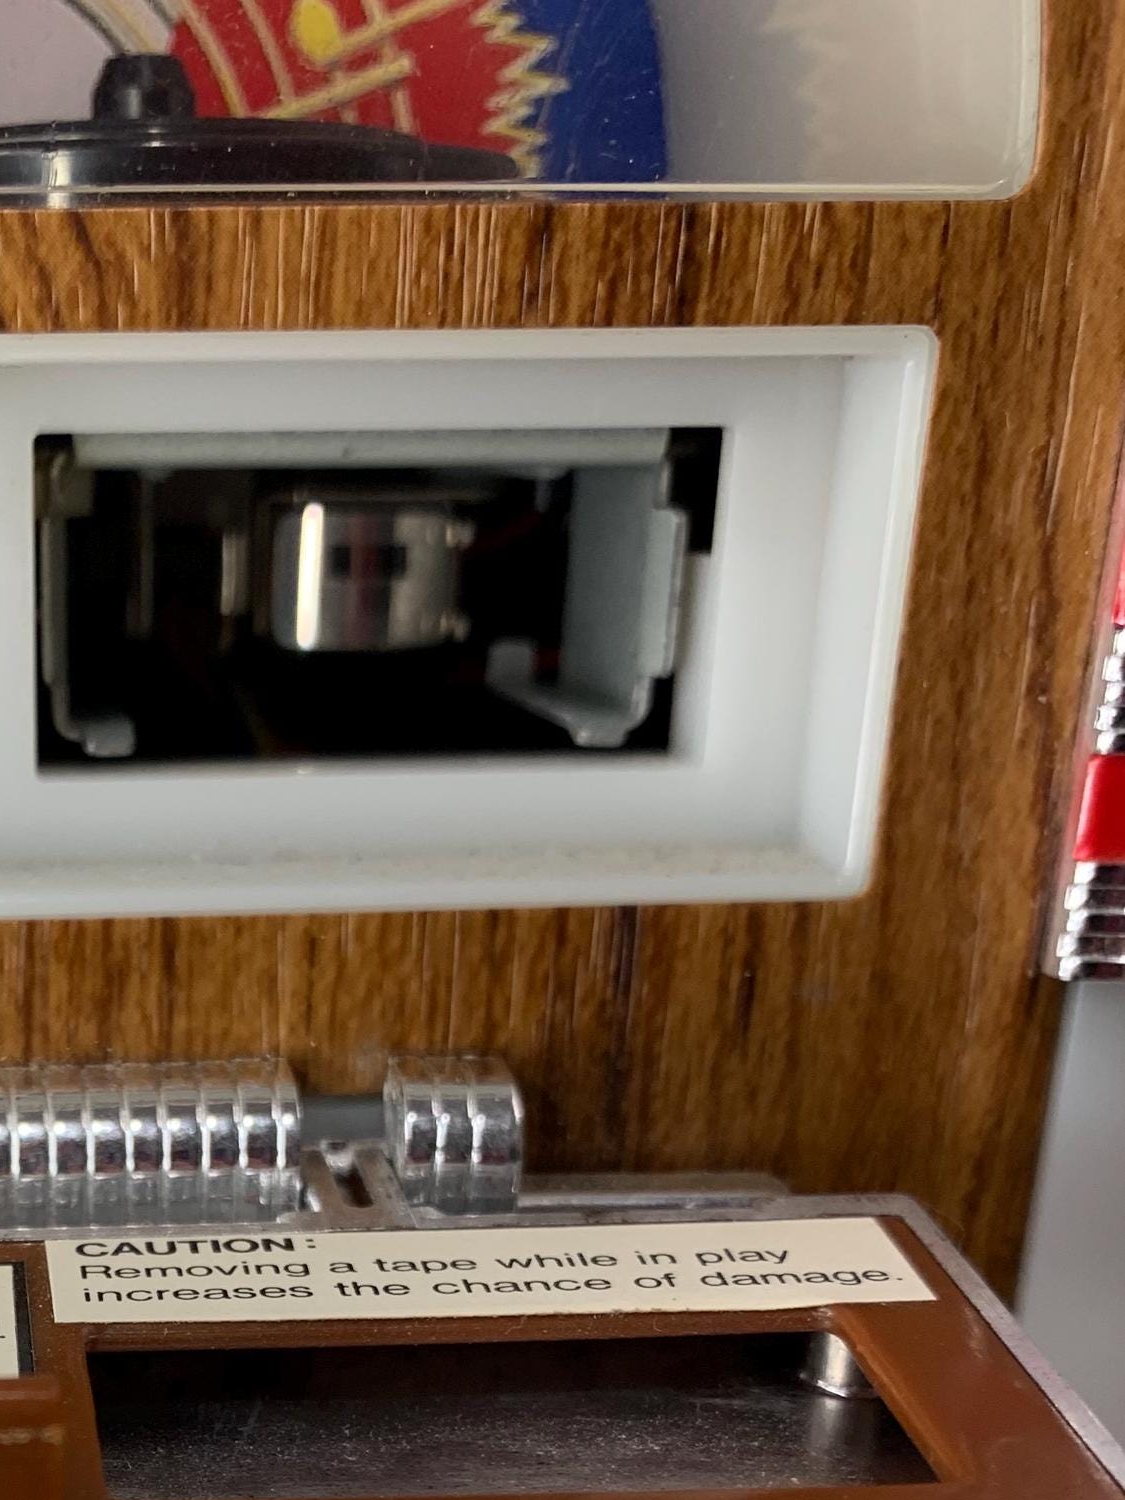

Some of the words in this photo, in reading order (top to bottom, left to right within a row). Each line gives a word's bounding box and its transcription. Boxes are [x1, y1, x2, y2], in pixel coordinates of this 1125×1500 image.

[79, 1260, 311, 1280] Removing
[328, 1261, 359, 1274] a
[372, 1257, 478, 1275] tape
[494, 1252, 618, 1270] while
[634, 1250, 678, 1266] in
[694, 1247, 789, 1267] play
[82, 1285, 315, 1303] increases
[333, 1280, 411, 1297] the
[431, 1278, 613, 1295] chance
[634, 1271, 677, 1289] of
[699, 1269, 904, 1287] damage.
